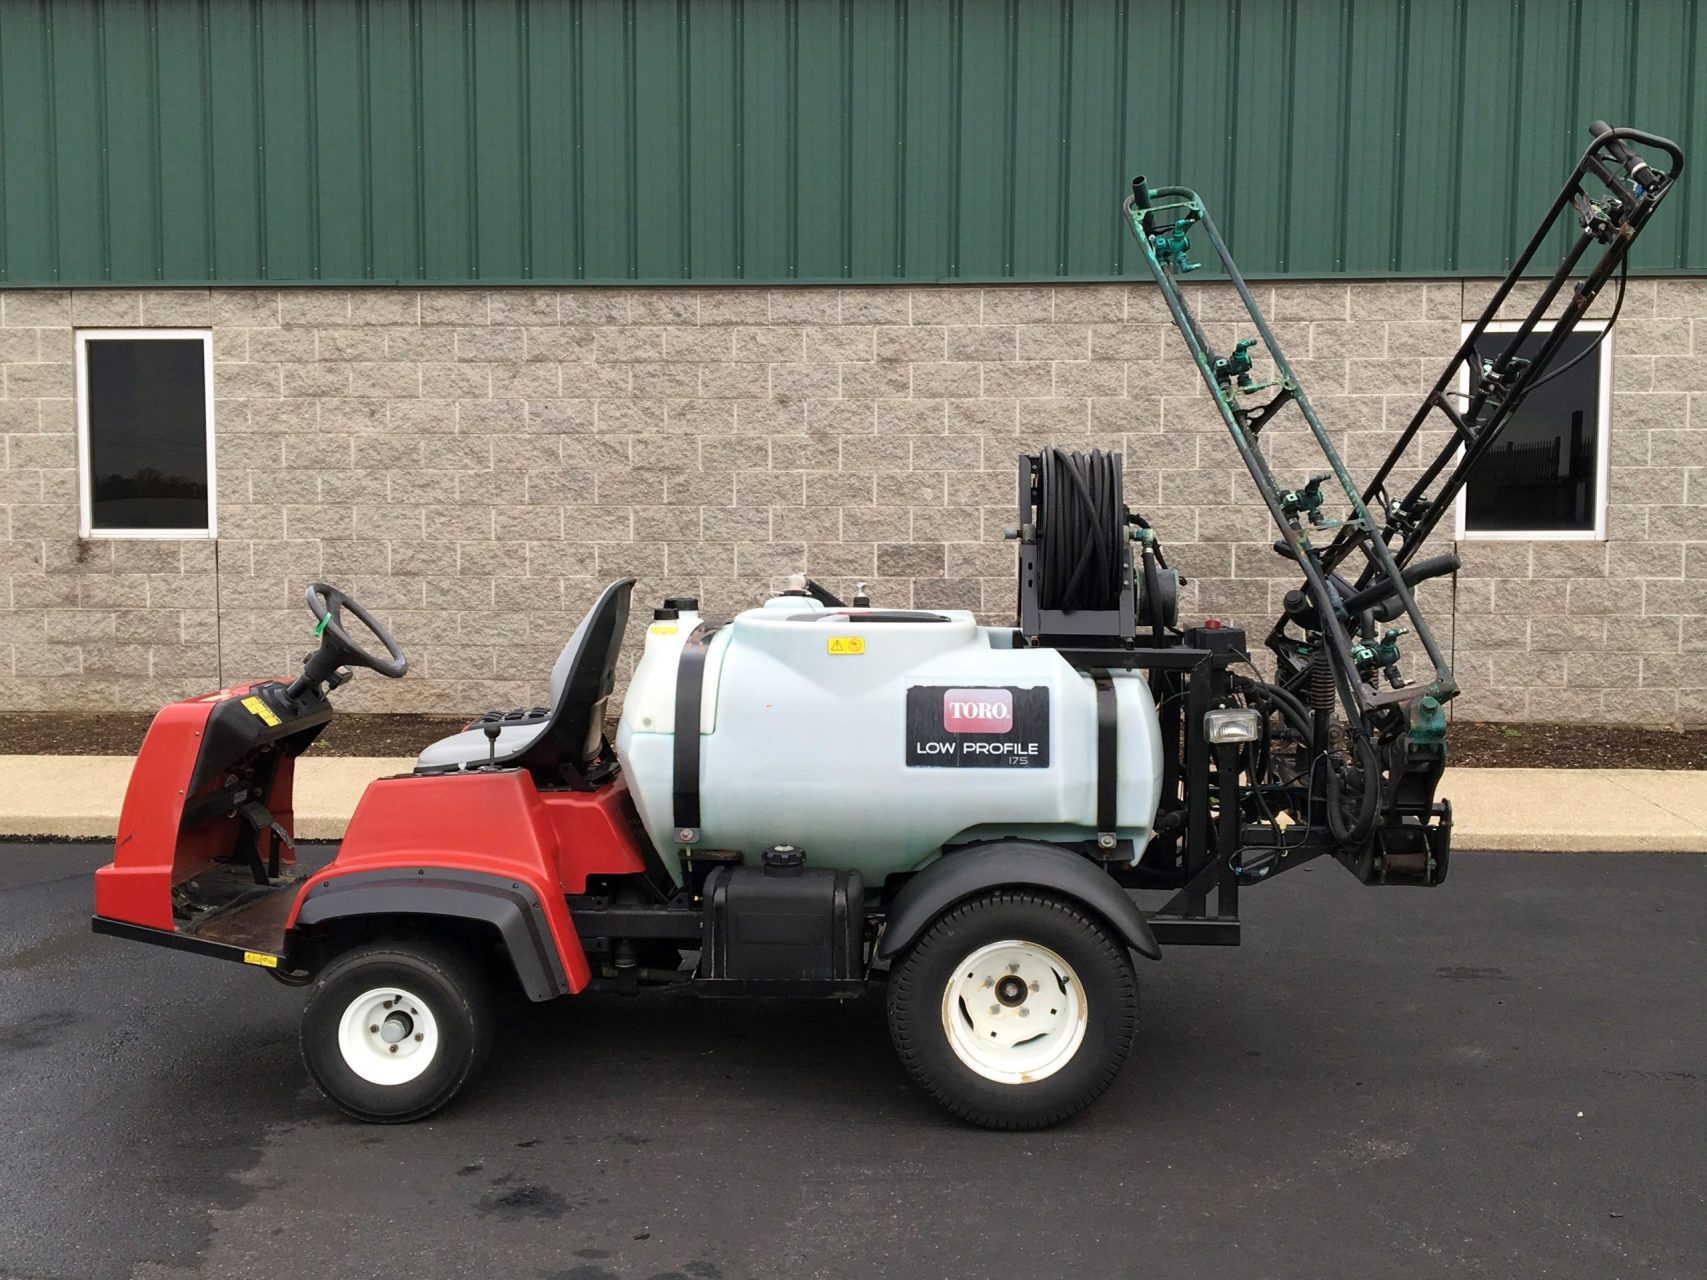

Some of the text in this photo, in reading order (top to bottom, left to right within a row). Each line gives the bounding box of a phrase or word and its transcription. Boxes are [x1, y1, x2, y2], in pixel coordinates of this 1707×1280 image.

[949, 702, 1008, 719] TORO
[916, 742, 1039, 755] LOW PROFILE
[1008, 756, 1029, 765] 175
